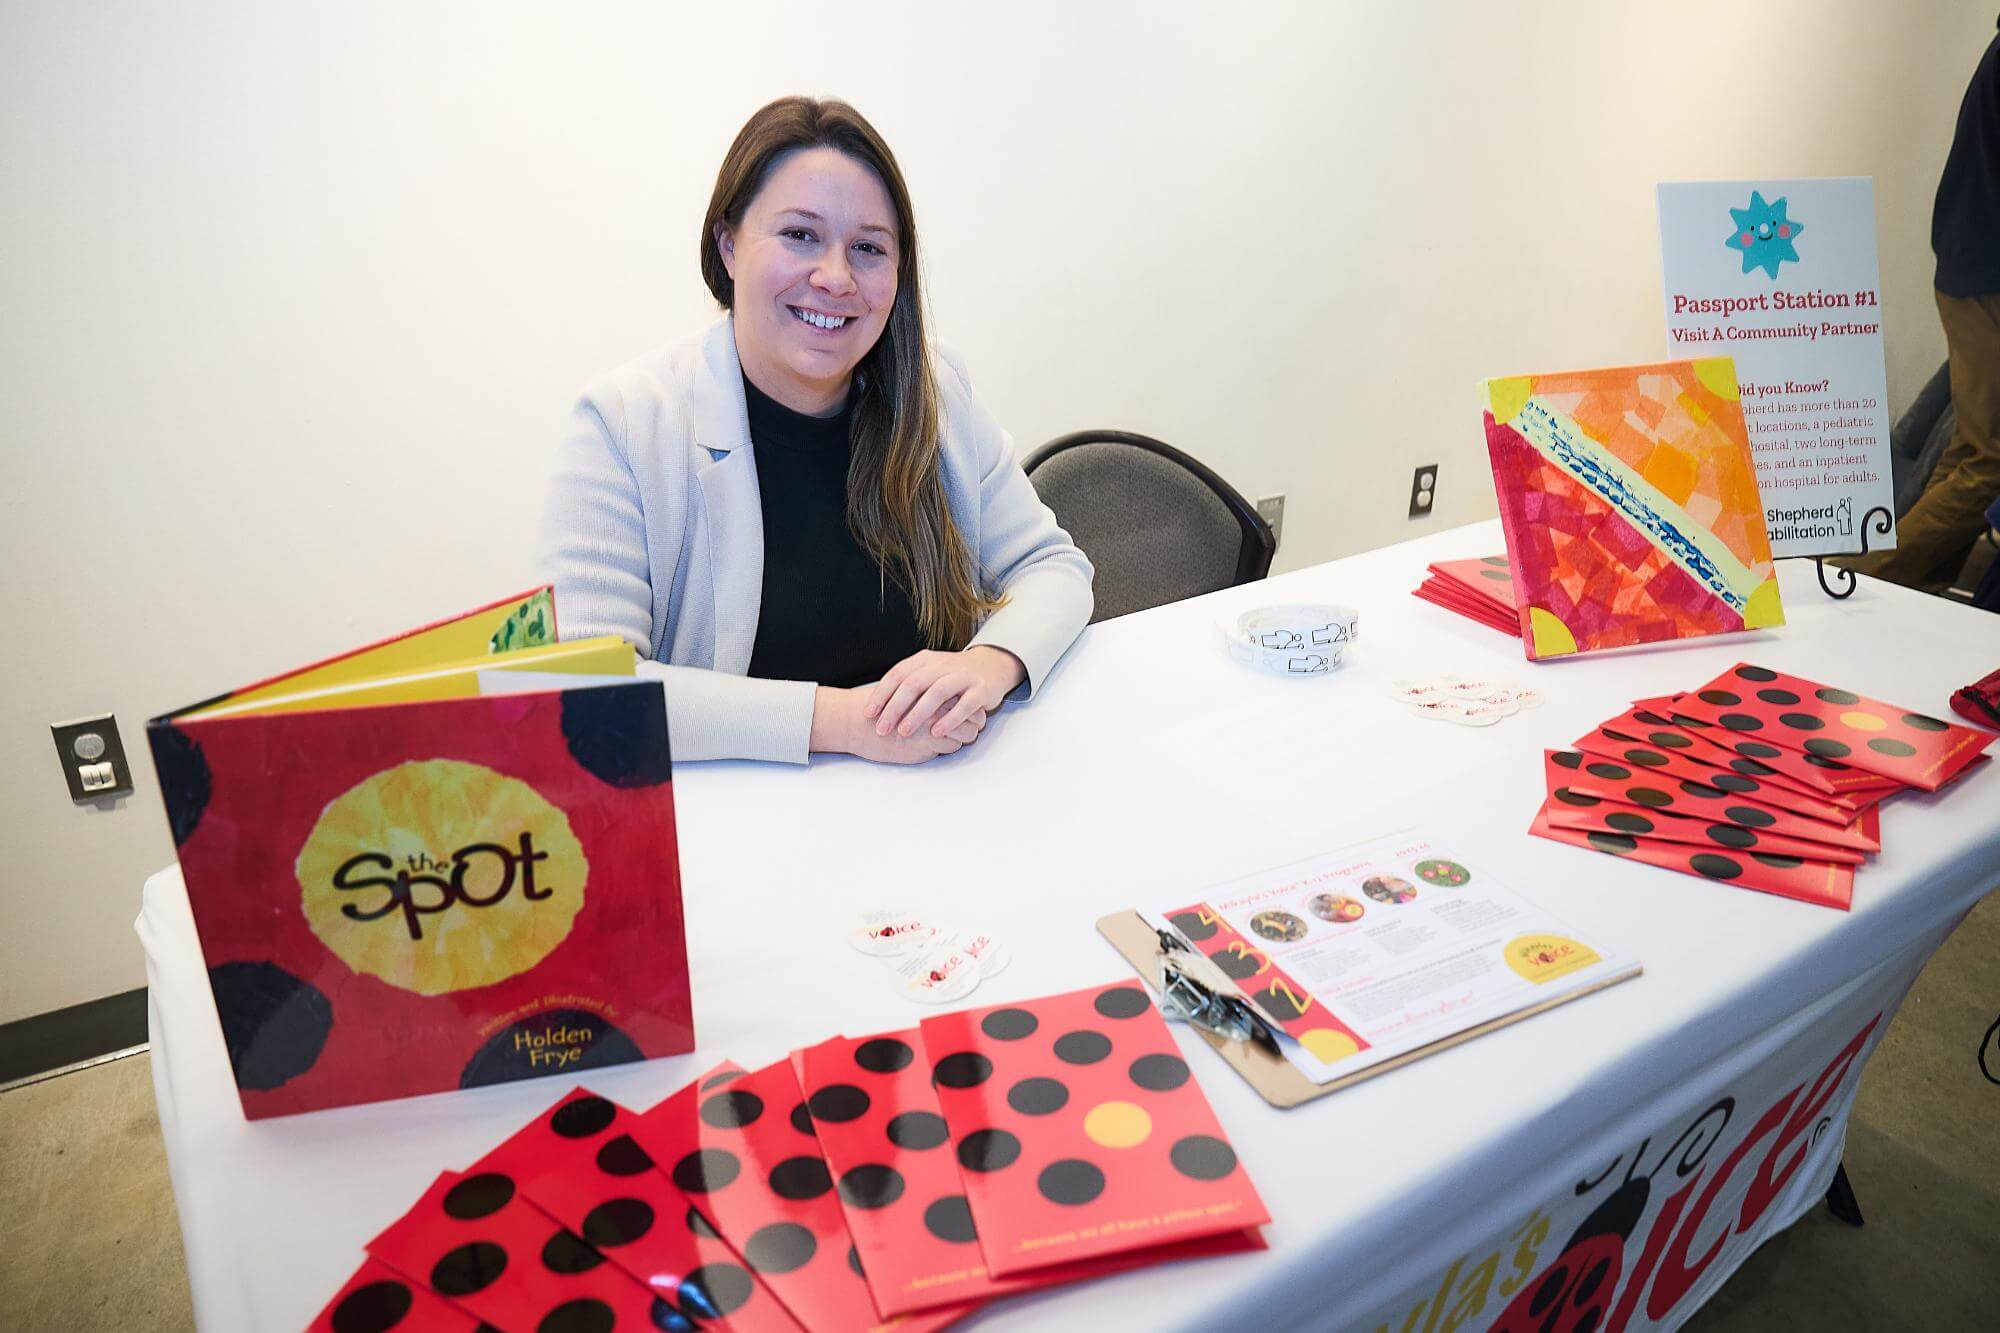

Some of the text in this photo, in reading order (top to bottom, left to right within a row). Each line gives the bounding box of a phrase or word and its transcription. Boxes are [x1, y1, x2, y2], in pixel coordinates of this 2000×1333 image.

[1673, 289, 1878, 317] Passport Station #1
[1672, 322, 1879, 342] Visit A Community Partner
[1758, 385, 1782, 398] you
[1785, 379, 1830, 394] Know?
[1777, 401, 1798, 413] has
[1800, 402, 1830, 411] more
[1833, 399, 1859, 410] than
[1862, 398, 1877, 409] 20
[1756, 420, 1811, 433] locations,
[1813, 421, 1820, 430] a
[1823, 416, 1874, 431] pediatric
[1794, 438, 1817, 449] two
[1819, 436, 1877, 449] long-term
[1774, 456, 1796, 469] and
[1799, 458, 1813, 468] an
[1816, 453, 1867, 468] inpatient
[1775, 474, 1820, 490] hospital
[1823, 472, 1840, 484] for
[1842, 471, 1880, 483] adults.
[1767, 504, 1834, 525] Shepherd
[406, 852, 449, 875] the
[1198, 902, 1233, 934] 4
[1228, 941, 1273, 975] 3
[1270, 977, 1314, 1014] 2
[514, 1025, 593, 1051] Holden
[529, 1047, 583, 1068] Frye
